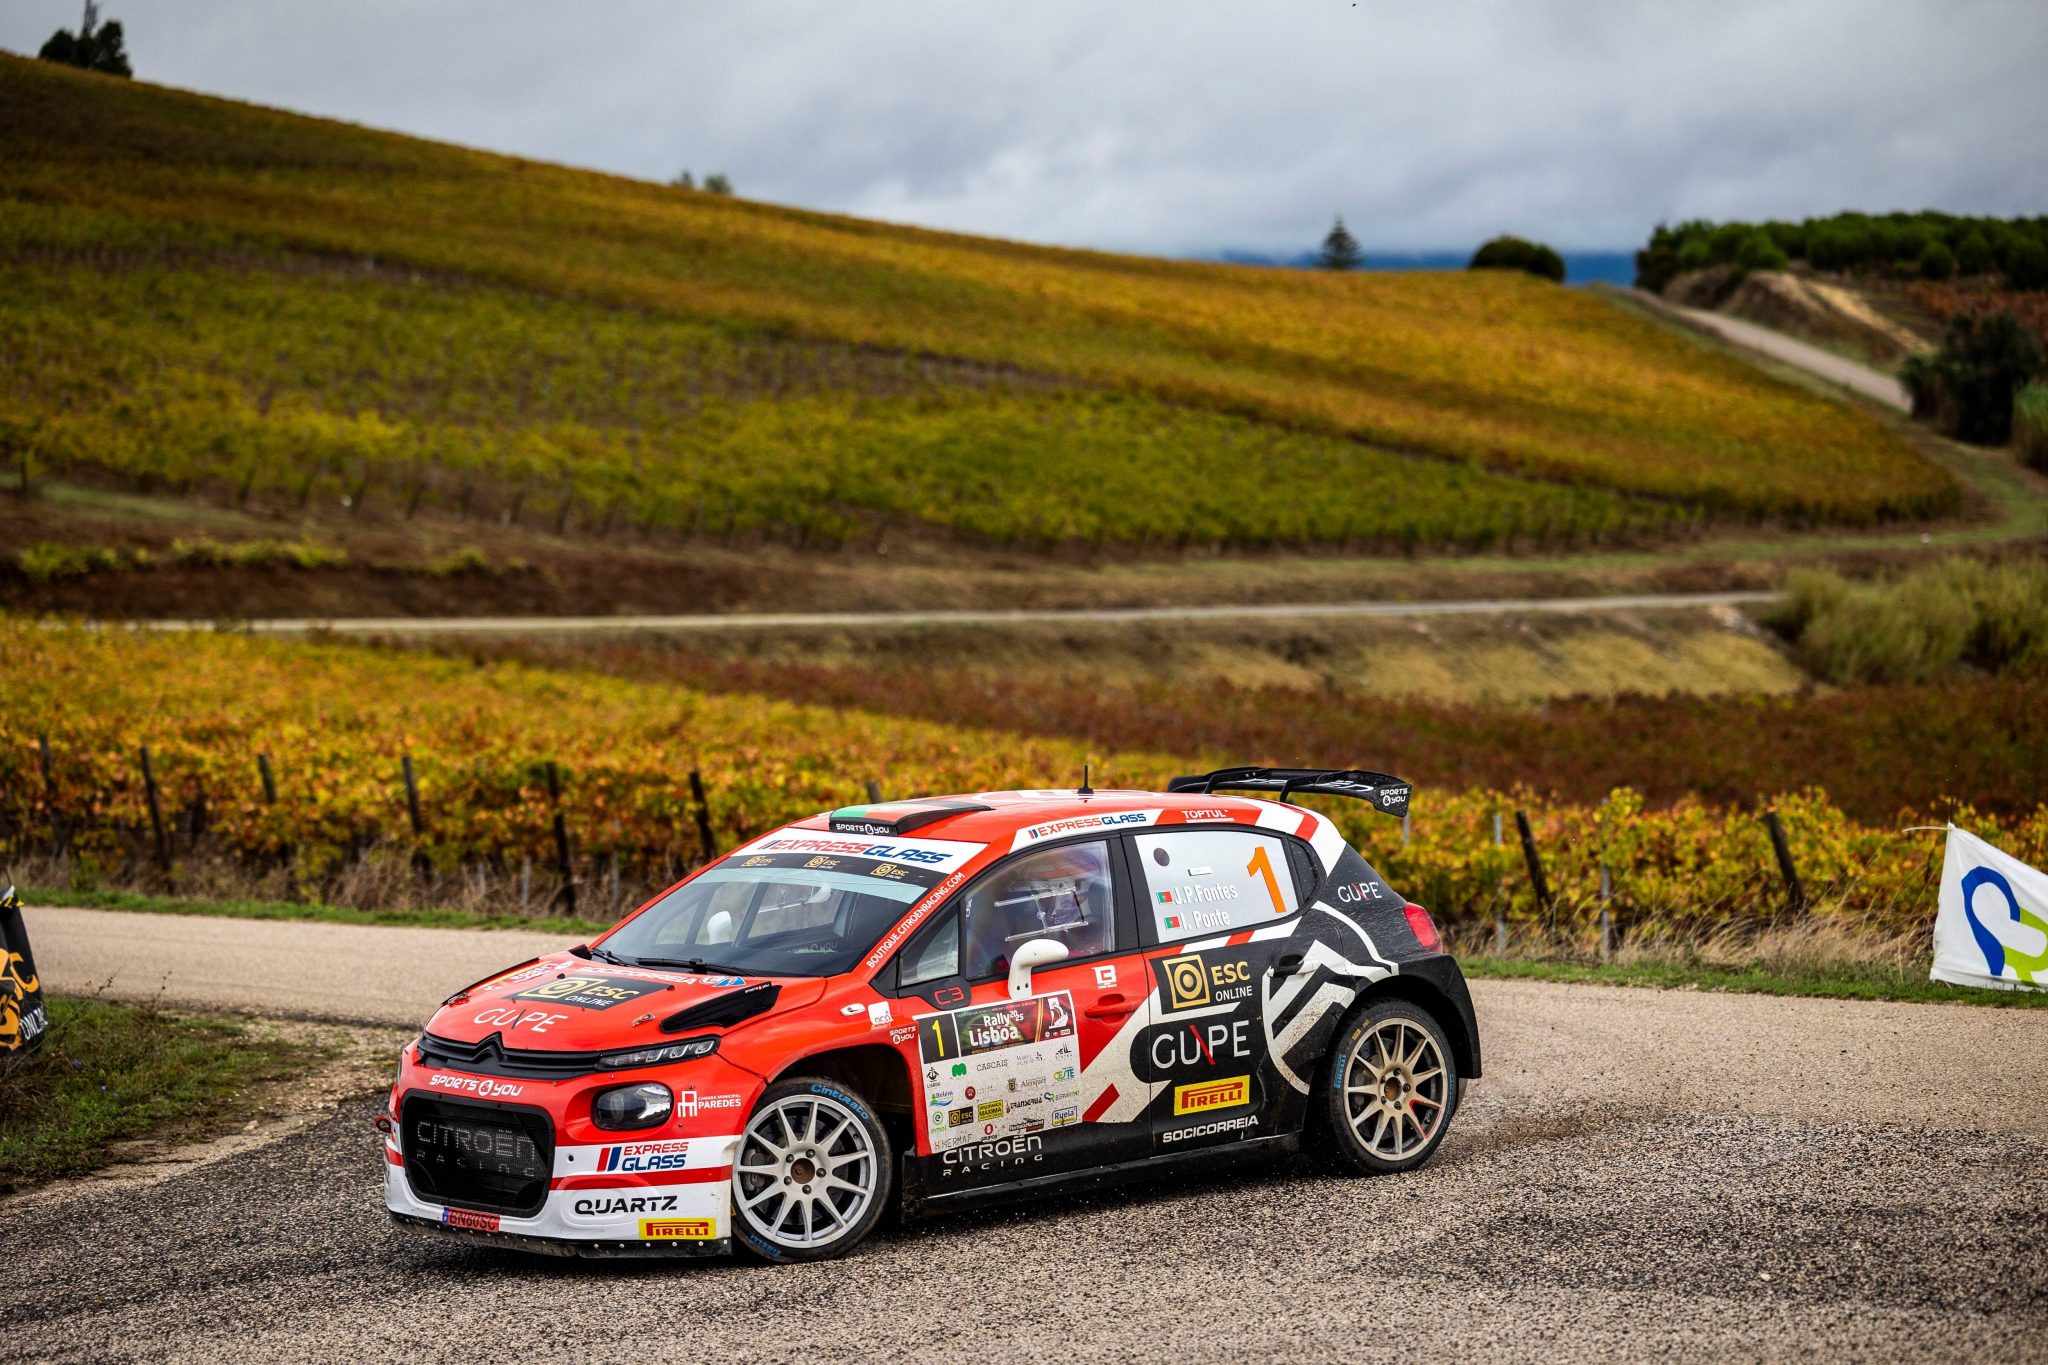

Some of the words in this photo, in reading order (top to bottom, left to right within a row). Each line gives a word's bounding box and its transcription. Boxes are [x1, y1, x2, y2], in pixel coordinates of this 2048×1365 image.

[1380, 787, 1408, 797] SPORTS
[1039, 813, 1147, 836] EXPRESSGLASS
[1181, 809, 1227, 820] TOPTUL
[774, 839, 953, 864] EXPRESSGLASS
[1247, 846, 1287, 913] 1
[866, 871, 965, 969] BOUTIQUE.CITROENRACING.COM
[1193, 908, 1231, 929] Ponte
[1211, 960, 1250, 985] ESC
[565, 995, 614, 1008] ONLINE
[582, 985, 640, 1000] ESC
[934, 986, 965, 1005] C3
[1216, 985, 1253, 1002] ONLINE
[983, 1012, 1011, 1028] Rally
[890, 1026, 916, 1036] SPORTS
[932, 1019, 945, 1058] 1
[969, 1026, 1019, 1047] Lisboa
[977, 1059, 1008, 1072] CASCAIS
[698, 1099, 741, 1109] PAREDES
[1182, 1082, 1244, 1109] PIRELLI
[1162, 1115, 1259, 1143] SOCICORREIA
[417, 1121, 536, 1160] CITROËN
[623, 1142, 689, 1156] EXPRESS
[943, 1134, 1042, 1165] CITROËN
[622, 1153, 687, 1171] GLASS
[943, 1154, 1043, 1177] RACING
[574, 1195, 678, 1216] QUARTZ
[646, 1222, 709, 1237] PIRELLI
